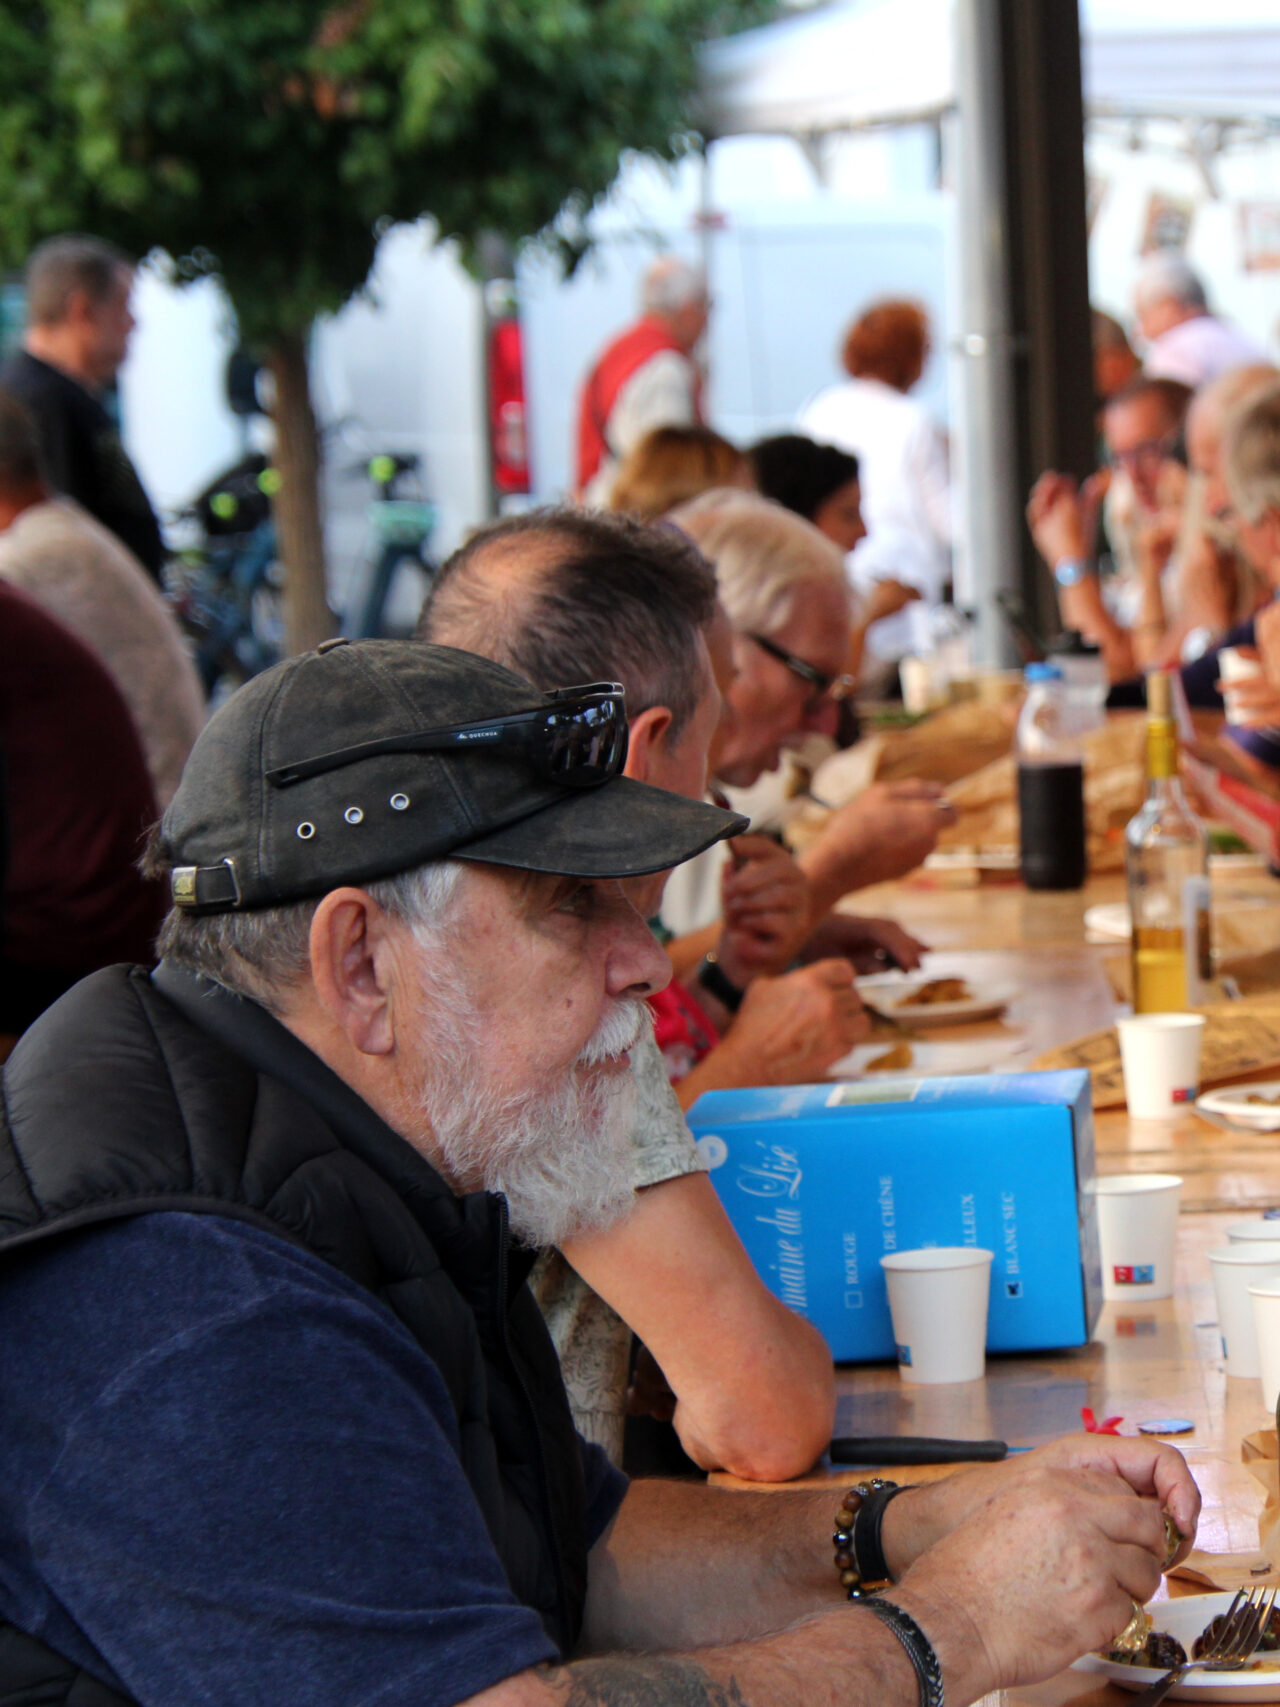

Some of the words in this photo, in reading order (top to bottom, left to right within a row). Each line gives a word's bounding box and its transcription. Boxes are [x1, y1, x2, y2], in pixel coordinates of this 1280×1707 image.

[1001, 1191, 1016, 1219] SEC
[755, 1208, 802, 1235] du
[883, 1229, 897, 1249] DE
[1004, 1221, 1019, 1274] BLANC
[843, 1231, 859, 1285] ROUGE
